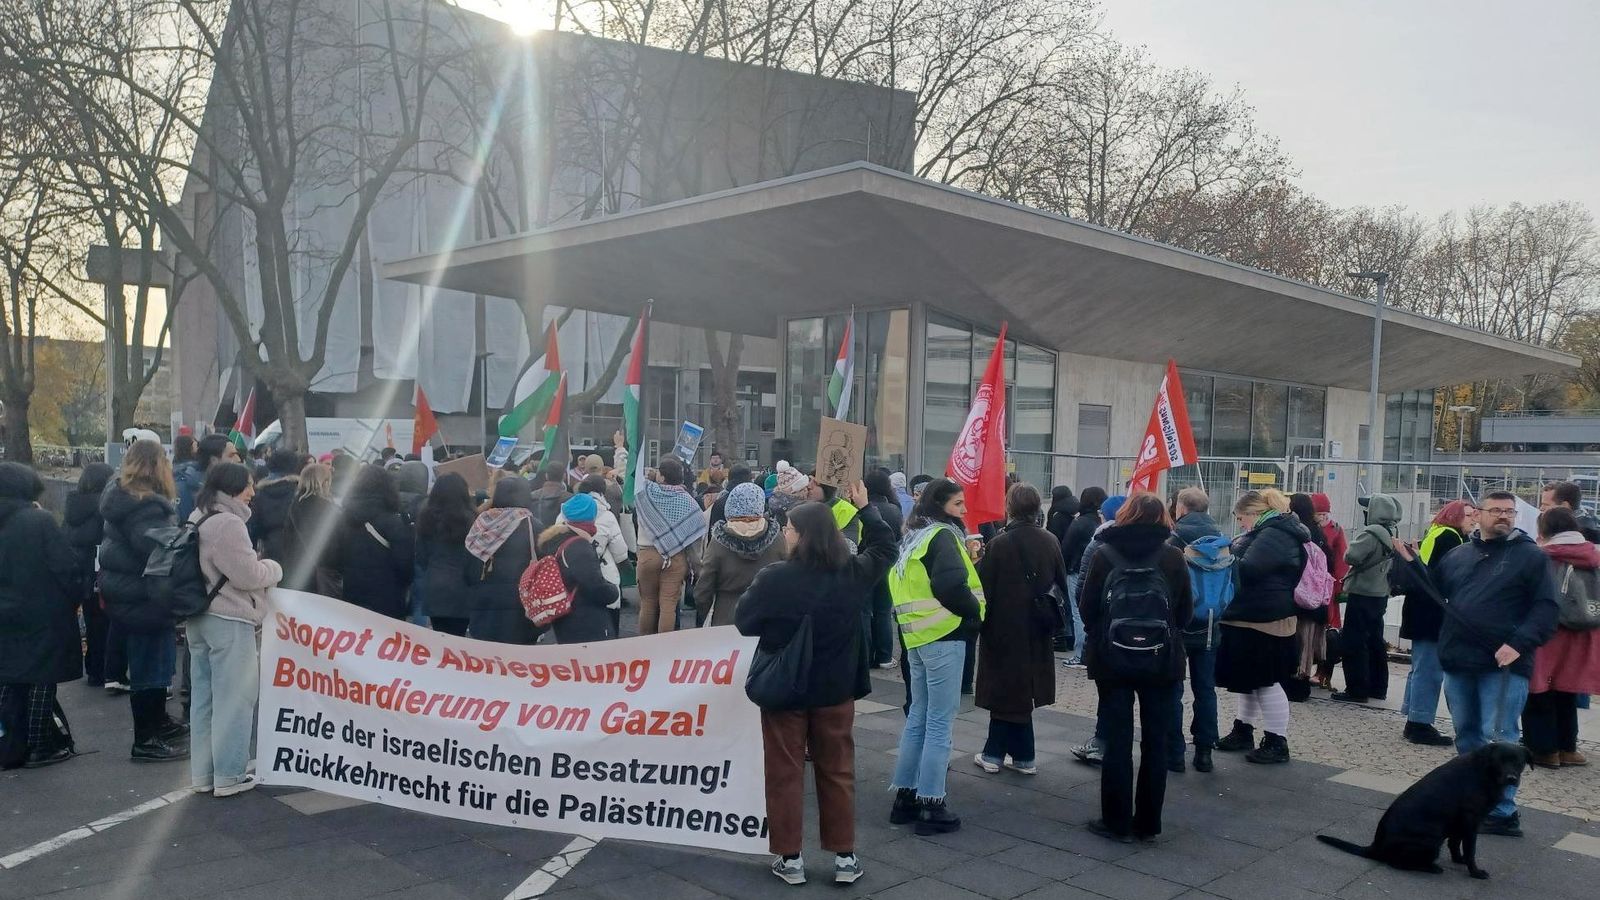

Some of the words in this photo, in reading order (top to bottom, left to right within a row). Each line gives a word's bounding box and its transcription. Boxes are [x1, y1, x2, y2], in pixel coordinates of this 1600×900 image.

[275, 611, 373, 660] Stoppt
[377, 631, 431, 665] die
[437, 648, 651, 693] Abriegelung
[668, 650, 740, 685] und
[272, 657, 510, 732] Bombardierung
[516, 703, 591, 732] vom
[600, 701, 708, 737] Gaza!
[272, 747, 451, 802] Rückkehrrecht
[457, 781, 496, 813] für
[505, 788, 549, 818] die
[275, 707, 335, 740] Ende
[342, 719, 375, 749] der
[382, 728, 541, 777] israelischen
[550, 752, 731, 794] Besatzung!
